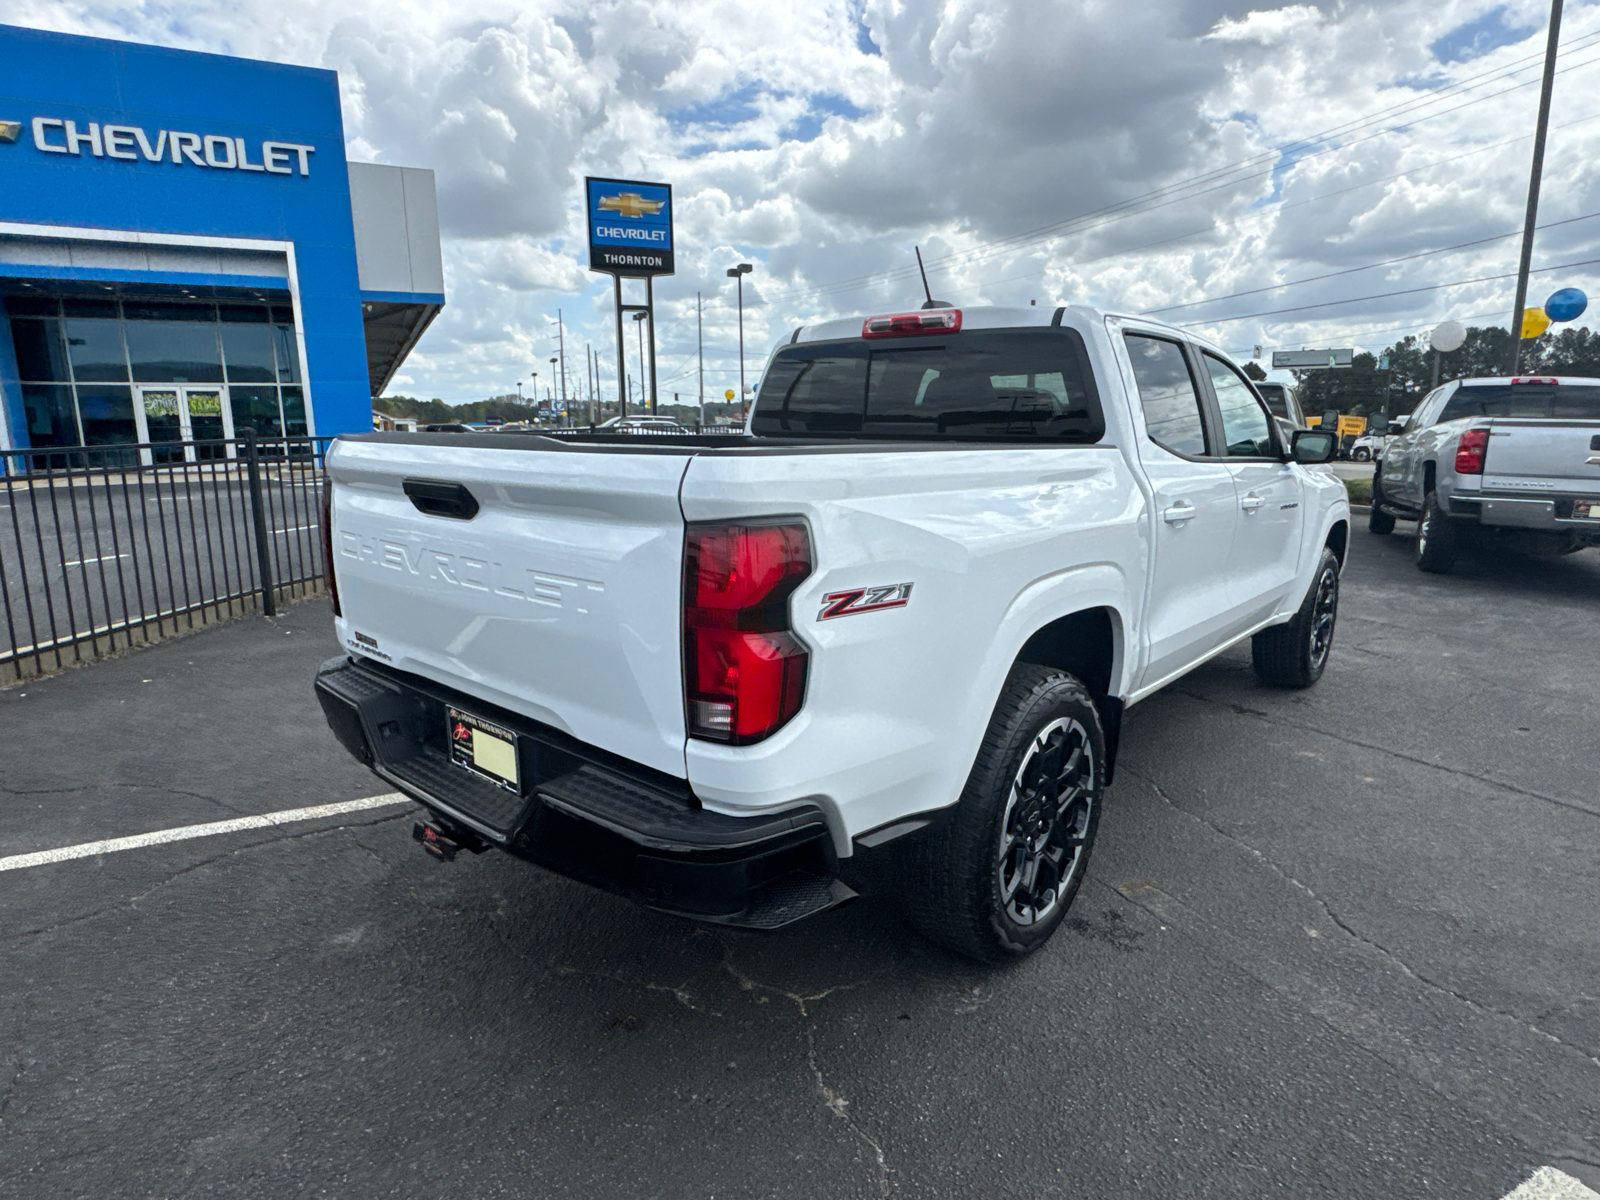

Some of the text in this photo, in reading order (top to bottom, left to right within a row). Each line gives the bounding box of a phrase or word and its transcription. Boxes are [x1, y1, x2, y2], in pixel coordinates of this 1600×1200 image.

[31, 116, 316, 177] CHEVROLET
[596, 226, 666, 241] CHEVROLET
[604, 254, 662, 266] THORNTON
[340, 530, 605, 614] CHEVROLET
[816, 582, 914, 622] Z71
